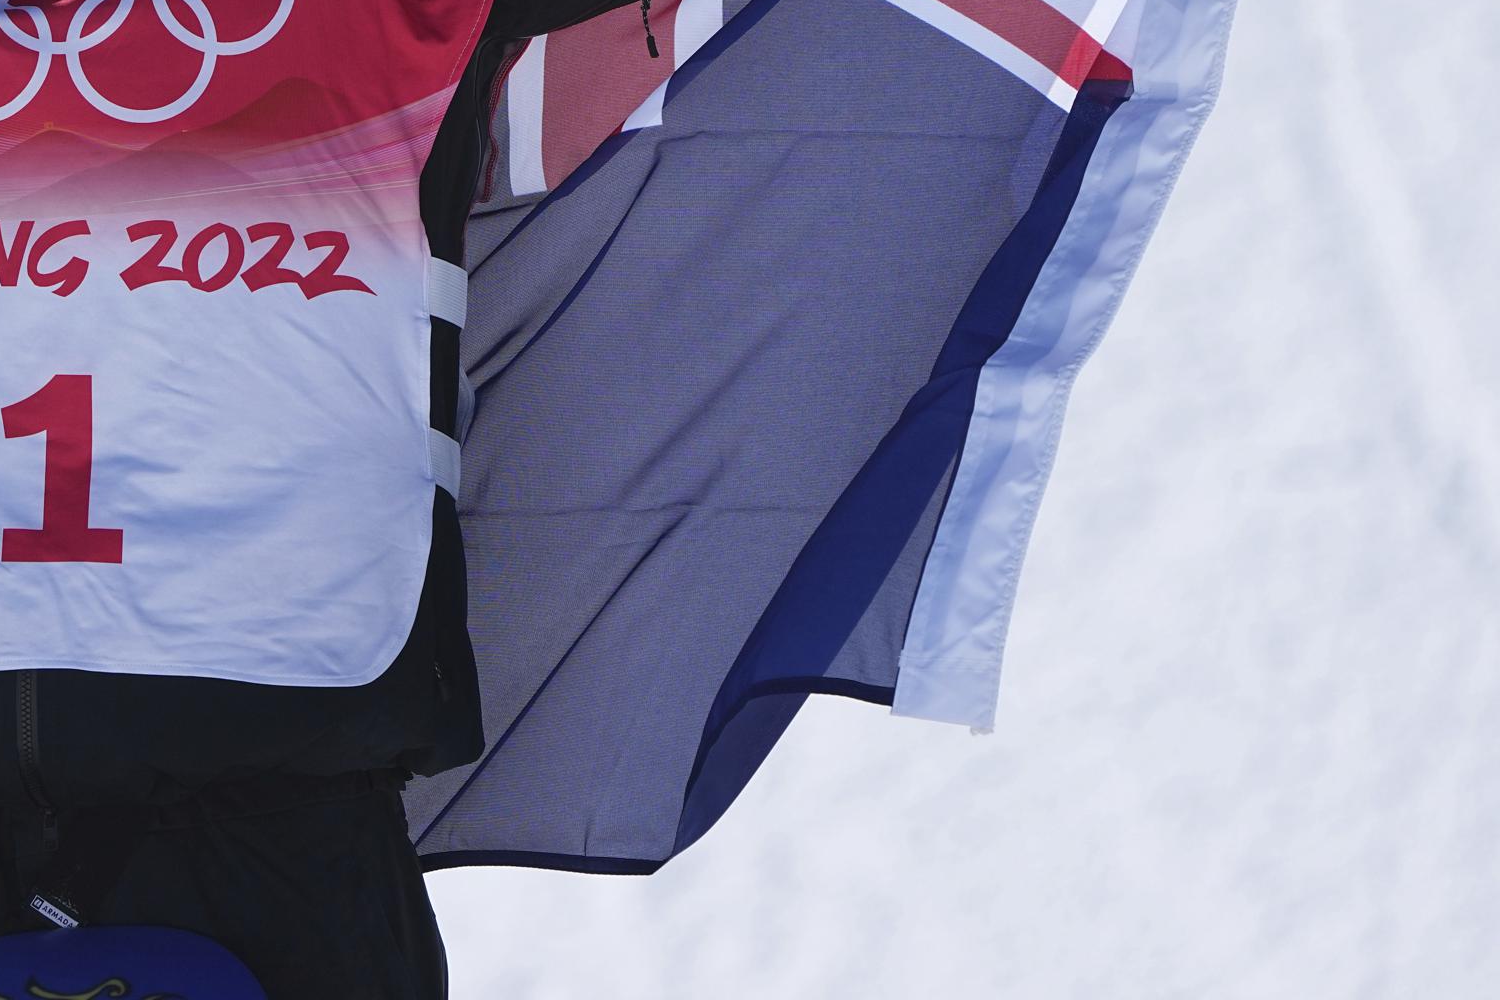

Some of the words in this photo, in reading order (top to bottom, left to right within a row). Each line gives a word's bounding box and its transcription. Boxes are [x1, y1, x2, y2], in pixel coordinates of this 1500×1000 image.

[119, 219, 378, 300] 2022
[0, 374, 124, 564] 1
[42, 905, 74, 928] ARMADA
